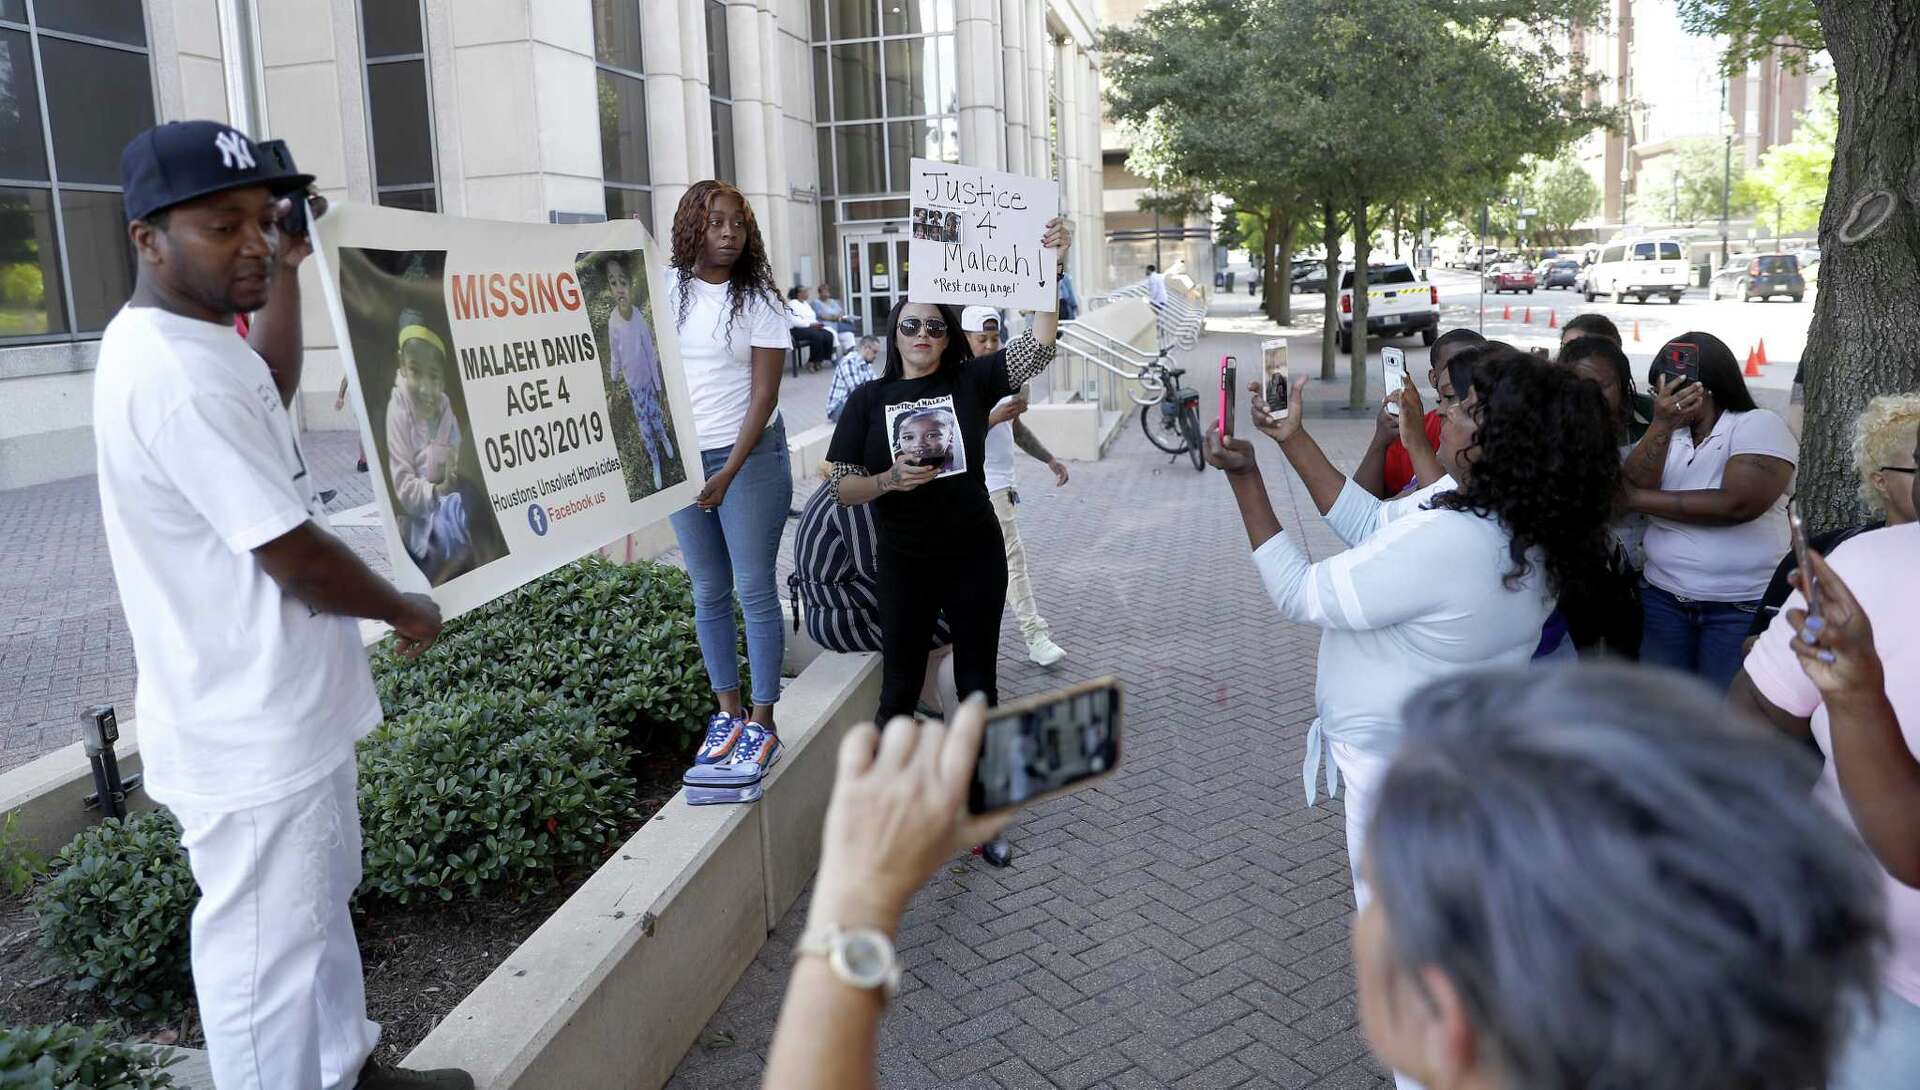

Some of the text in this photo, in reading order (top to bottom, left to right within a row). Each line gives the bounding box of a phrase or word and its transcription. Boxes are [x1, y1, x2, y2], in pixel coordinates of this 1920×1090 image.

[923, 172, 1027, 210] Justice
[452, 272, 582, 320] MISSING
[461, 333, 596, 381] MALAEH DAVIS
[507, 375, 571, 417] AGE 4
[485, 411, 604, 473] 05/03/2019
[491, 456, 621, 513] Houstons Unsolved Homicides
[547, 493, 593, 522] Facebook
[594, 491, 607, 505] us
